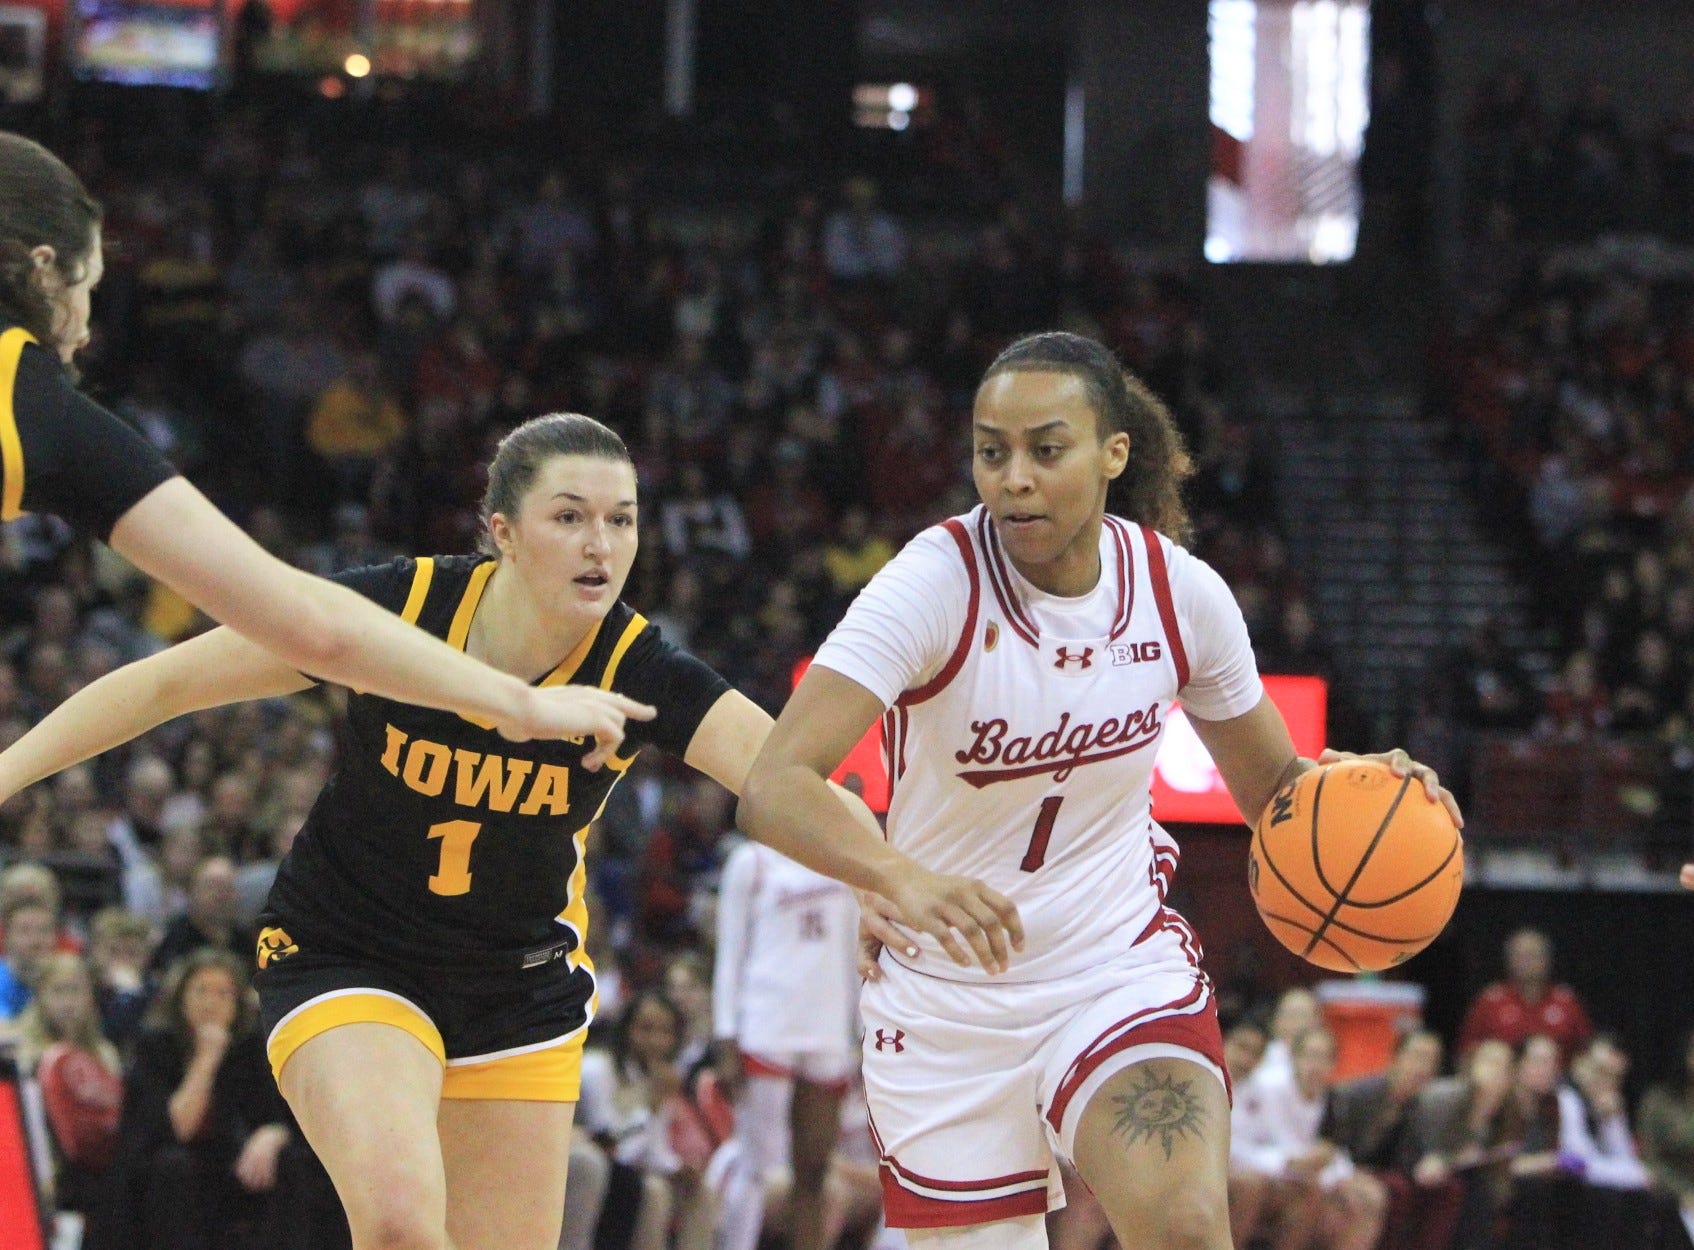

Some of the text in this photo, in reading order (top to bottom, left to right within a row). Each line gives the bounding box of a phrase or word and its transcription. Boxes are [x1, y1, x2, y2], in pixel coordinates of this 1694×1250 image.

[380, 722, 570, 816] IOWA
[955, 702, 1161, 783] Badgers
[427, 819, 482, 896] 1
[1020, 796, 1064, 873] 1
